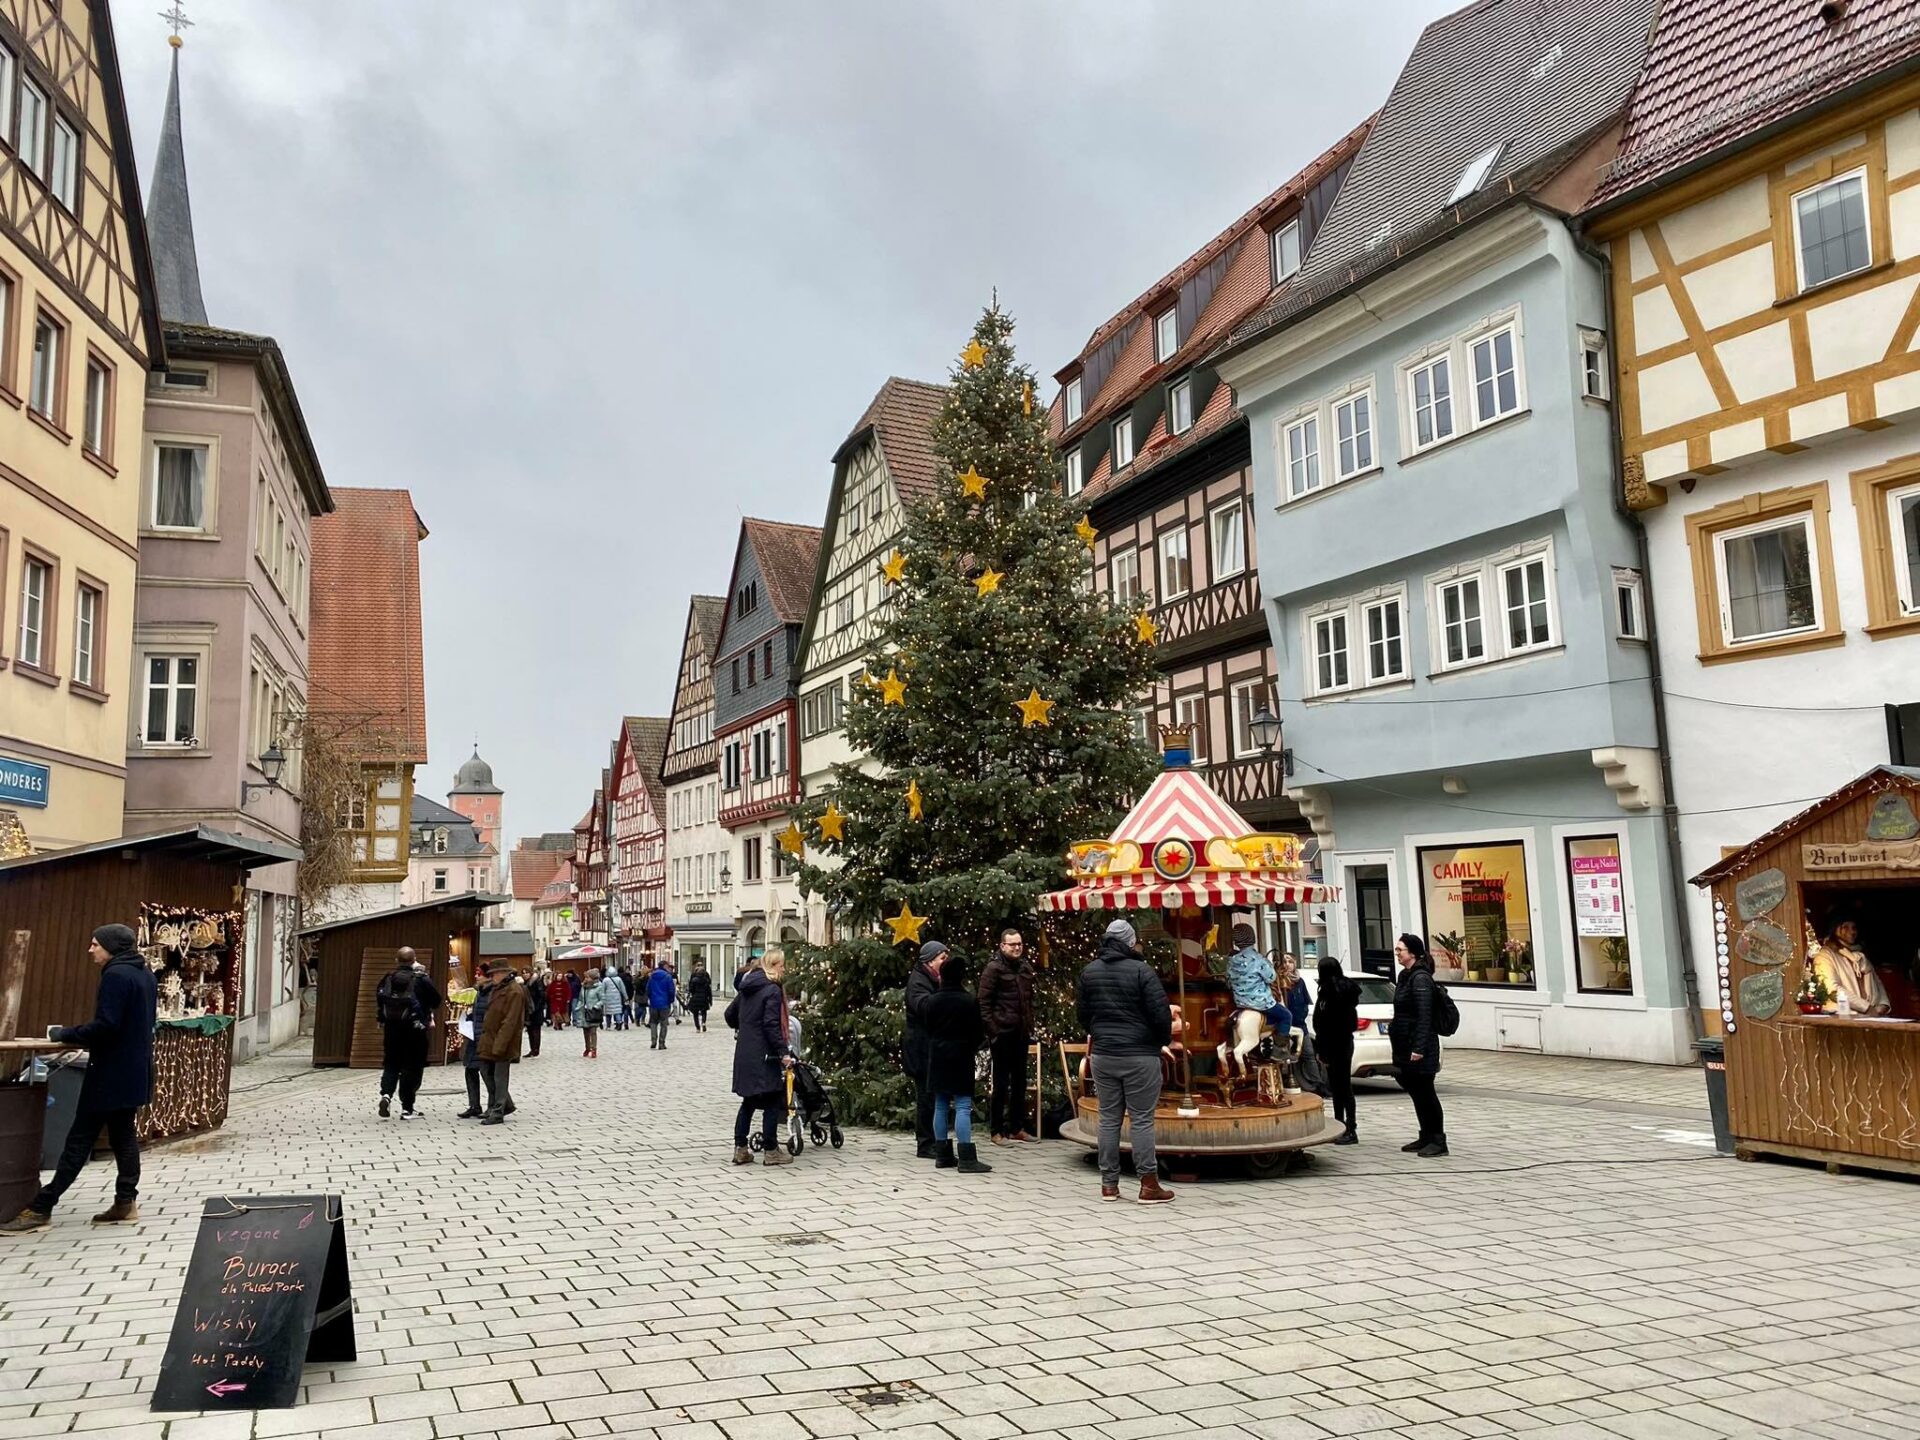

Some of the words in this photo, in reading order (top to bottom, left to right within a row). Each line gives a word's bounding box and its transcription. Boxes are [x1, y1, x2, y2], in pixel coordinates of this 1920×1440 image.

[1810, 848, 1888, 866] Bratwurst
[1433, 861, 1483, 879] CAMLY
[1448, 891, 1488, 902] American
[1490, 891, 1512, 903] Style
[223, 1255, 299, 1285] Burger
[275, 1280, 305, 1292] Pork
[191, 1353, 216, 1366] Hot
